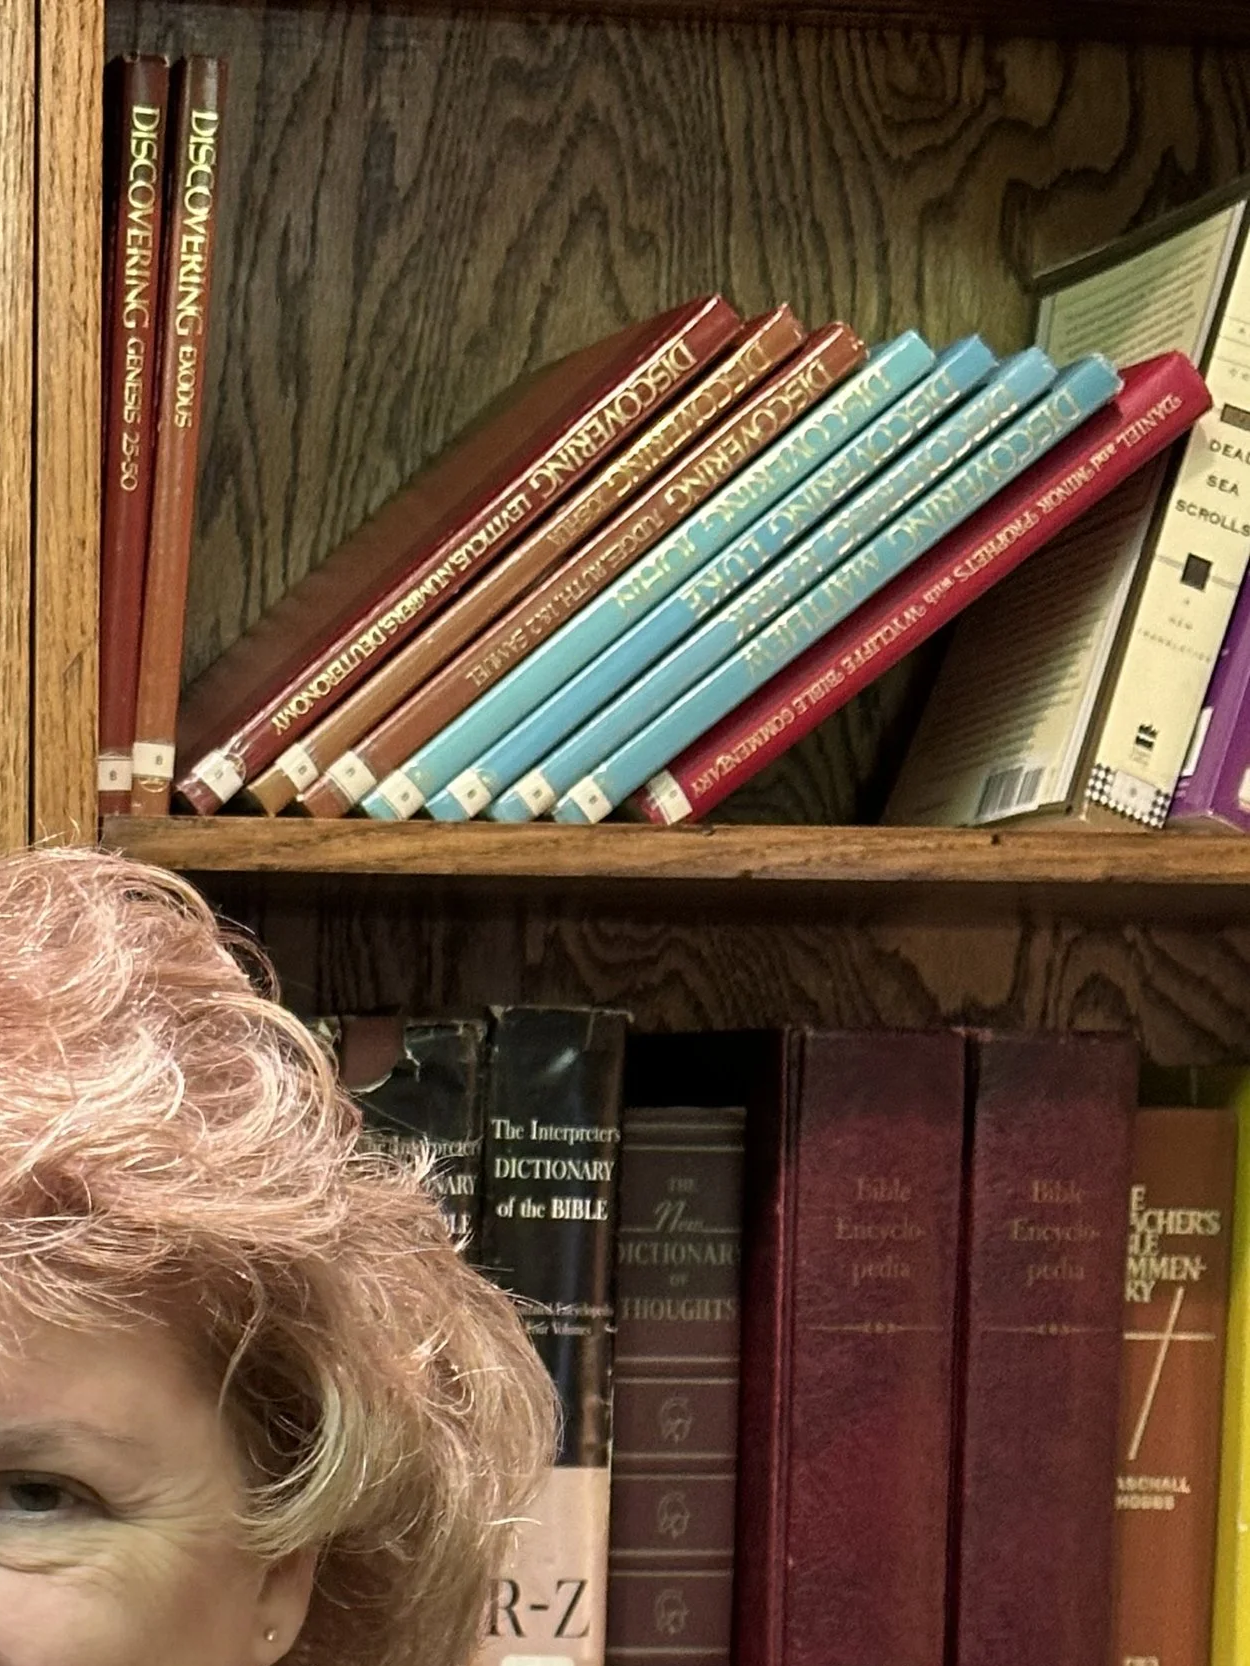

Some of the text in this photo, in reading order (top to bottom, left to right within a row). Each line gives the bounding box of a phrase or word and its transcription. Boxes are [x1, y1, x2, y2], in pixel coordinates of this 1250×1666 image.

[122, 105, 160, 330] DISCOVERING
[174, 109, 220, 429] DISCOVERING EXODUS
[122, 337, 145, 425] GENESIS
[524, 337, 700, 501] DISCOVERING
[601, 340, 774, 498] DISCOVERING
[658, 356, 836, 515] DISCOVERING
[693, 367, 896, 538] DISCOVERING
[1087, 440, 1121, 472] and
[1112, 389, 1184, 451] DANIEL
[676, 369, 964, 620] DISCOVERING LUKE
[881, 387, 1086, 557] DISCOVERING
[1034, 461, 1096, 516] MINOR
[1206, 475, 1239, 496] SEA
[950, 506, 1041, 583] PROPHETS
[732, 544, 892, 680] MATTHEW
[921, 574, 957, 608] with
[463, 626, 532, 689] SAMUEL
[838, 600, 928, 675] WYCLIFFE
[266, 624, 387, 737] DEUTERONOMY
[790, 666, 845, 715] BIBLE
[491, 1118, 525, 1141] The
[494, 1157, 615, 1182] DICTIONARY
[496, 1197, 608, 1221] of the BIBLE
[488, 1578, 590, 1639] R-Z
